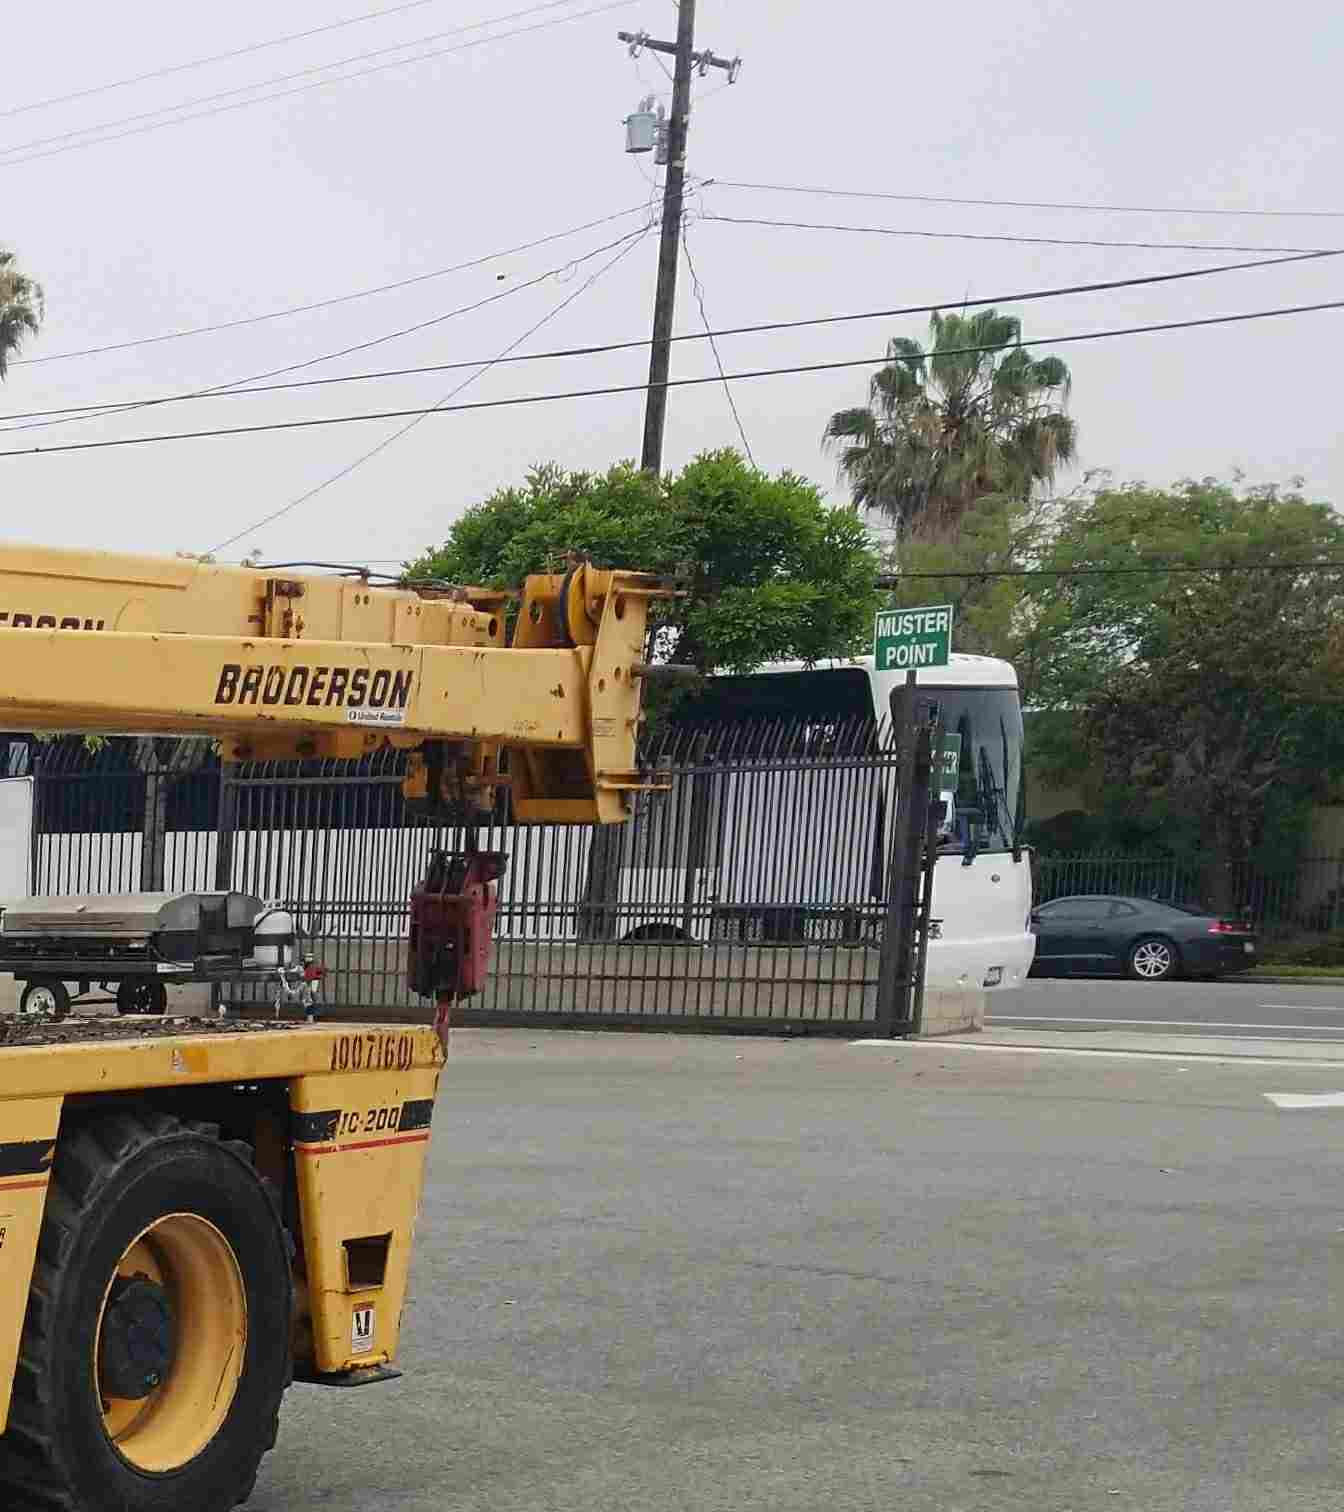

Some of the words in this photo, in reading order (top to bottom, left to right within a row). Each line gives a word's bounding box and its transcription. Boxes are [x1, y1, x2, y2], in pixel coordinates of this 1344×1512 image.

[878, 611, 949, 637] MUSTER
[886, 642, 938, 666] POINT
[215, 663, 414, 708] BRODERSON
[330, 1034, 414, 1072] 10071601
